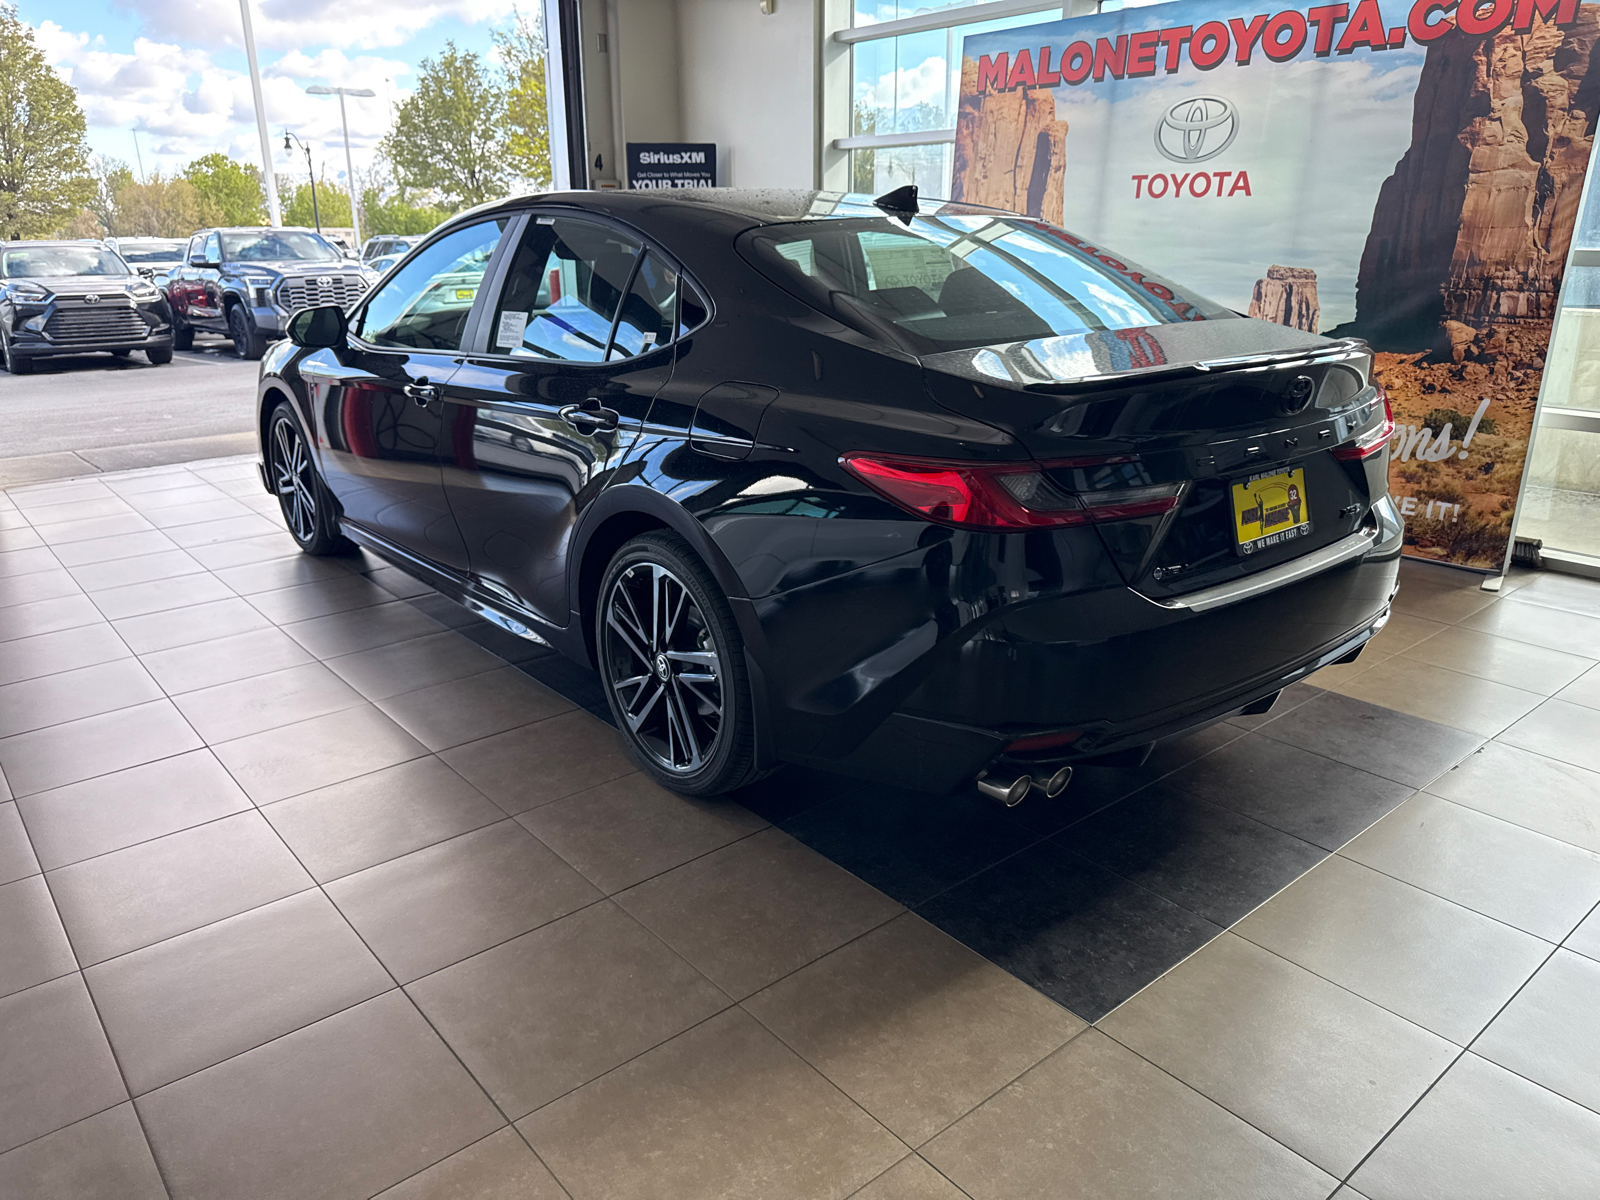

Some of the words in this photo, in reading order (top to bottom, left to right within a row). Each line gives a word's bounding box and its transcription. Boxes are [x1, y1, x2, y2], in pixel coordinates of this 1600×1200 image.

[977, 0, 1580, 94] MALONETOYOTA.COM
[594, 153, 603, 171] 4
[640, 152, 705, 164] SiriusXM
[632, 179, 672, 190] YOUR
[1131, 170, 1252, 199] TOYOTA
[1289, 489, 1297, 500] 32
[1394, 495, 1418, 516] E
[1425, 500, 1460, 522] IT!
[1257, 539, 1265, 549] WE
[1265, 534, 1280, 546] MAKE
[1279, 532, 1285, 542] IT
[1285, 528, 1297, 540] EASY
